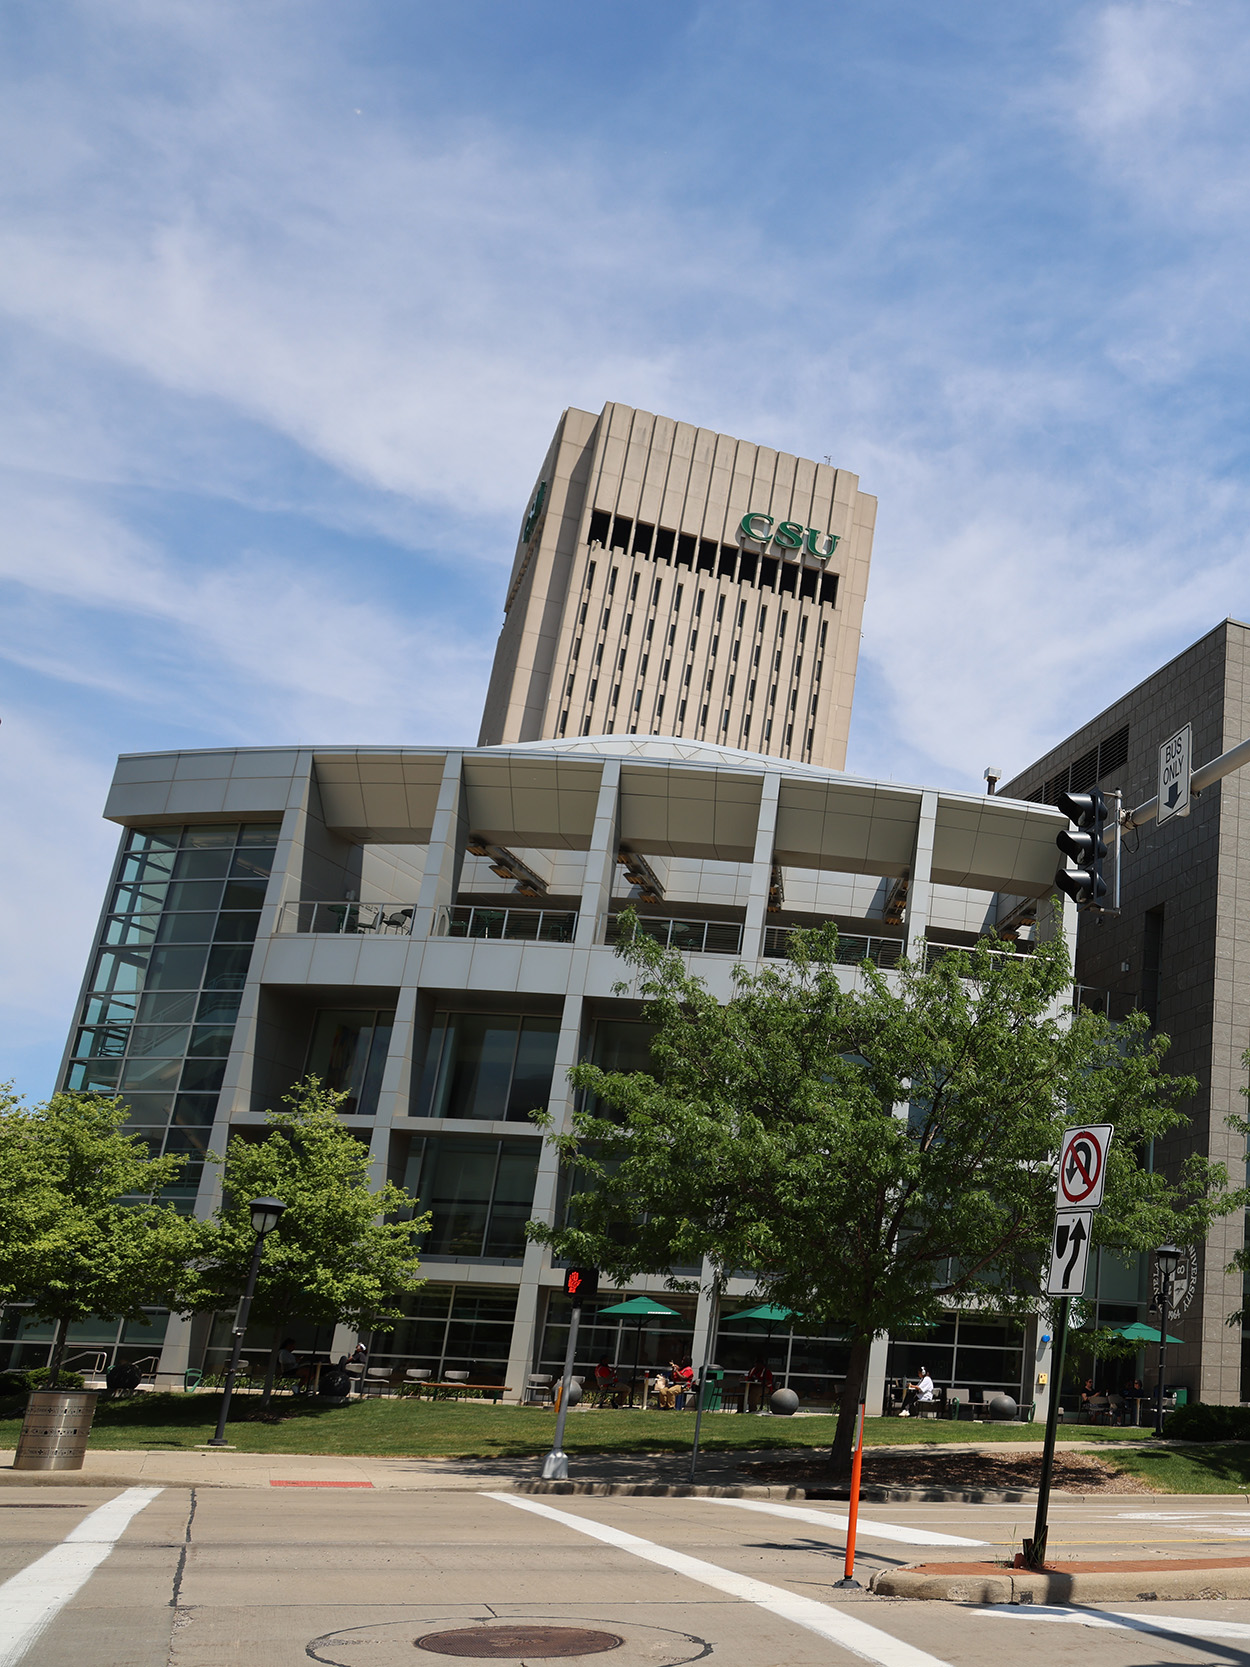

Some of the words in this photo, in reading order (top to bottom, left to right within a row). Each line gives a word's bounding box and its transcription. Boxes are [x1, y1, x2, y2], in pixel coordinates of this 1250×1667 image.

[741, 512, 841, 557] CSU
[1166, 736, 1182, 764] BUS
[1163, 755, 1184, 785] ONLY
